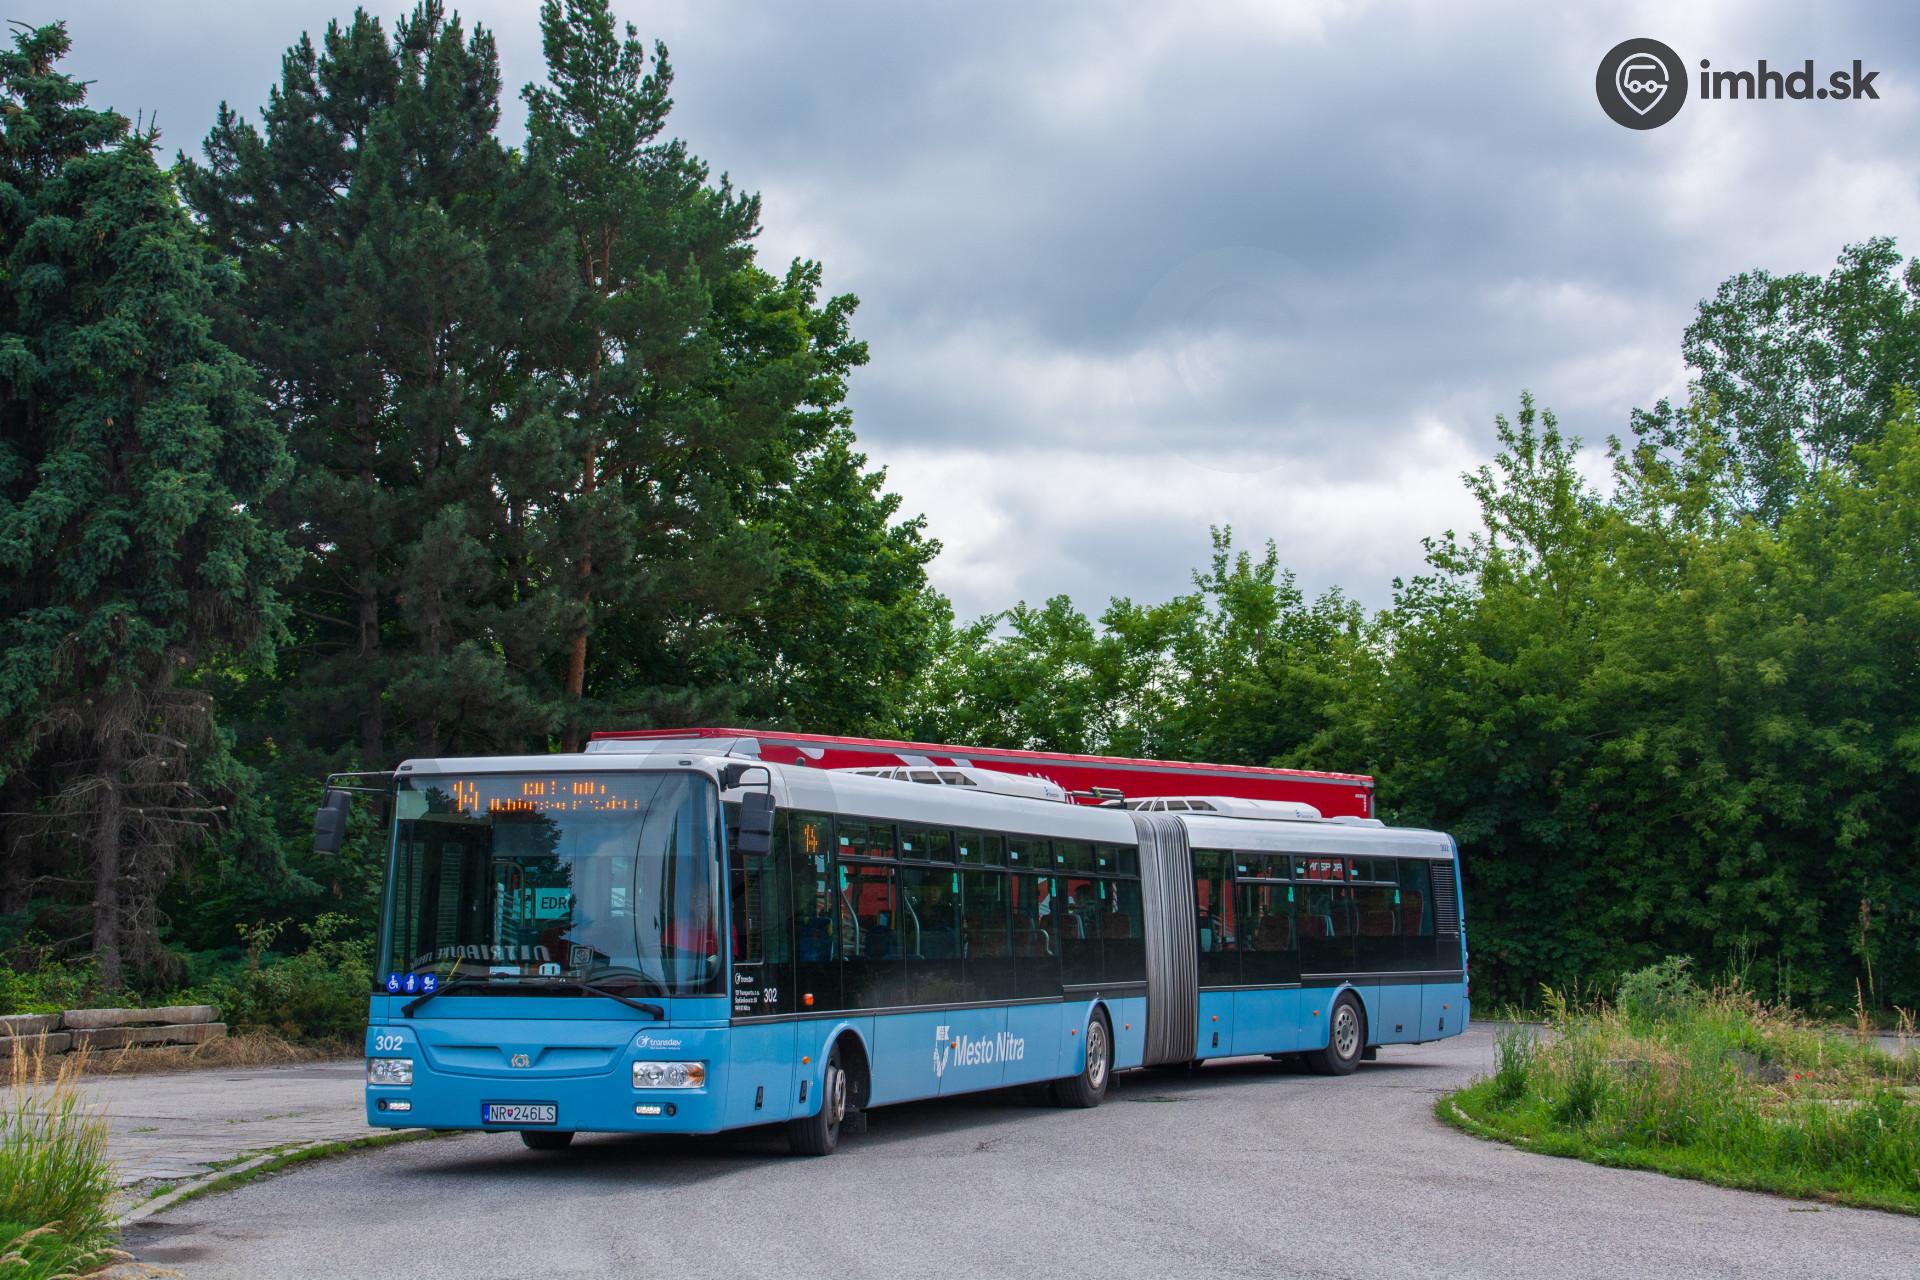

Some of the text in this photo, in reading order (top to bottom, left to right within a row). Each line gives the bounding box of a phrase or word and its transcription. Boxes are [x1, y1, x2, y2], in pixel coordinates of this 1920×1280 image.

[763, 987, 778, 1003] 302
[375, 1035, 403, 1051] 302
[953, 1031, 1025, 1067] Mesto Nitra
